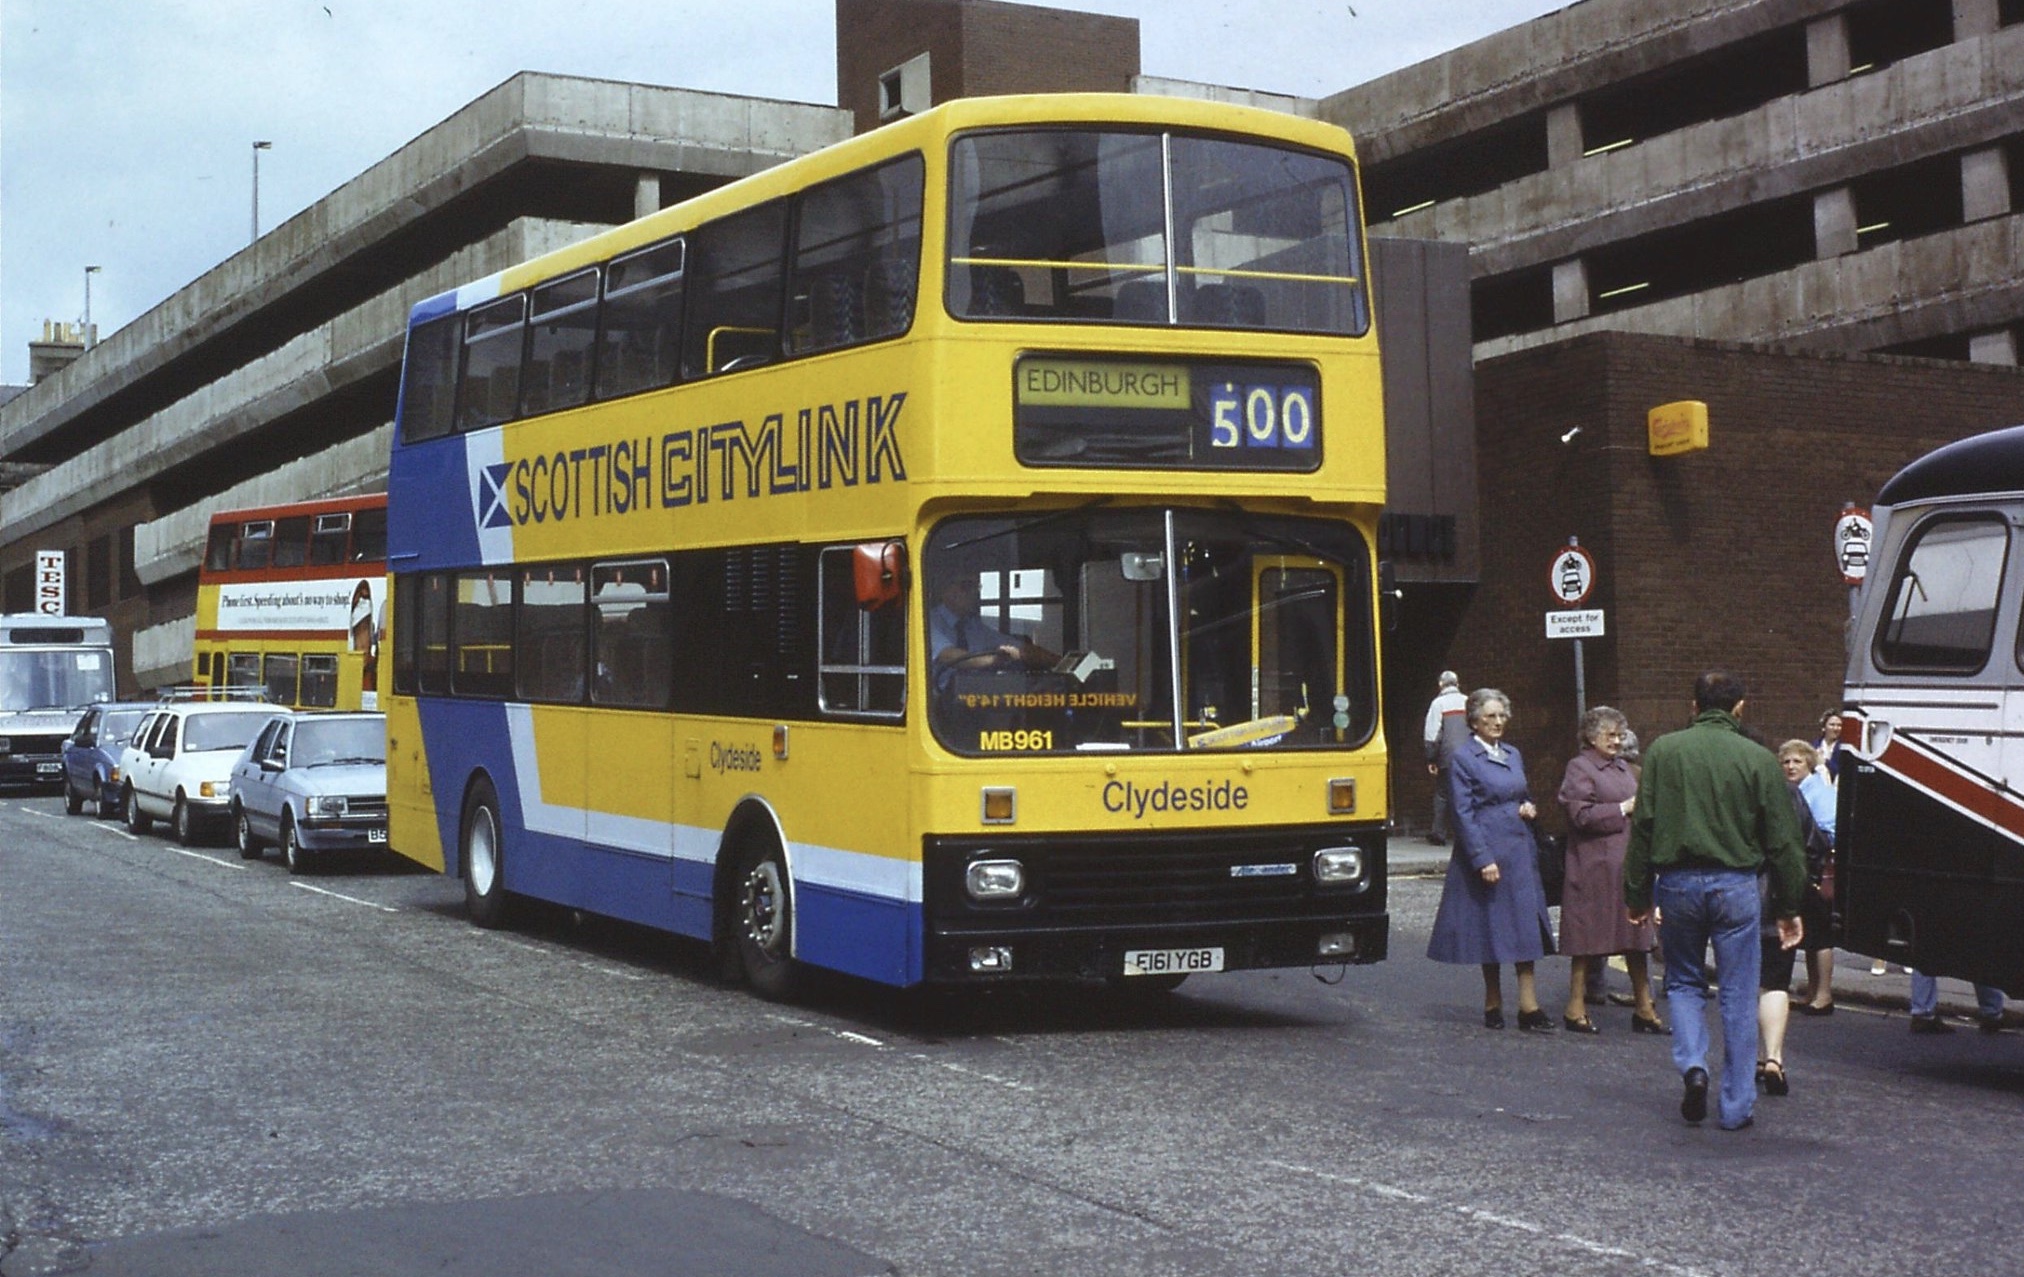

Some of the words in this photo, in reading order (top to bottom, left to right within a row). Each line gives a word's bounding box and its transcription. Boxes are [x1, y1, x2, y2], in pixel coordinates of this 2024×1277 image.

[1027, 369, 1179, 397] EDINBURGH
[1212, 388, 1311, 448] 500
[513, 437, 652, 526] SCOTTISH
[661, 392, 908, 509] CITYLINK
[1551, 615, 1582, 623] Except
[1586, 613, 1599, 622] for
[1560, 625, 1591, 634] access
[980, 730, 1053, 750] MB961
[710, 740, 762, 776] Clydeside
[1103, 779, 1249, 819] Clydeside
[1137, 952, 1171, 971] E161
[1175, 950, 1212, 969] YGB
